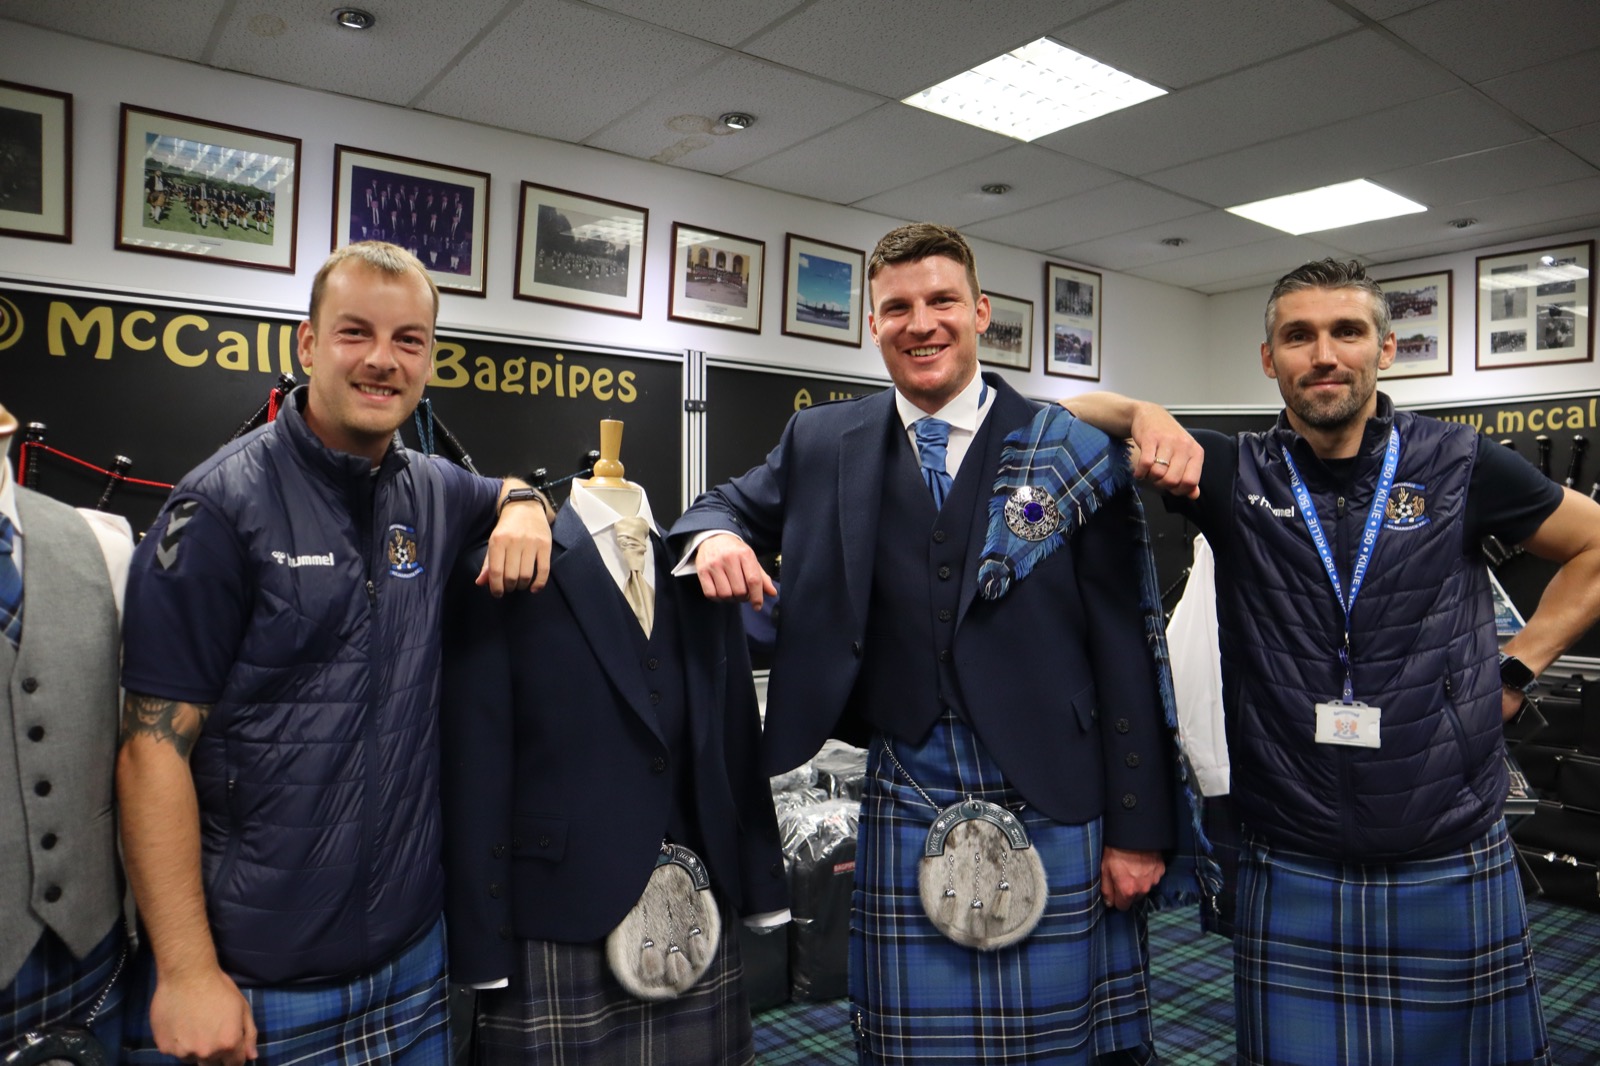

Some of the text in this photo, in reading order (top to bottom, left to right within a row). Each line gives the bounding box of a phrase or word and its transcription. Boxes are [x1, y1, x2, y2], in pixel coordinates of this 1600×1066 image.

[47, 301, 638, 403] McCall Bagpipes
[1287, 461, 1300, 488] KILLIE
[1383, 462, 1395, 479] 150
[1298, 493, 1311, 510] 150
[1371, 488, 1388, 519] KILLIE
[1307, 517, 1326, 548] KILLIE
[1363, 529, 1377, 545] 150
[1325, 556, 1335, 573] 150
[1353, 553, 1368, 585] KILLIE
